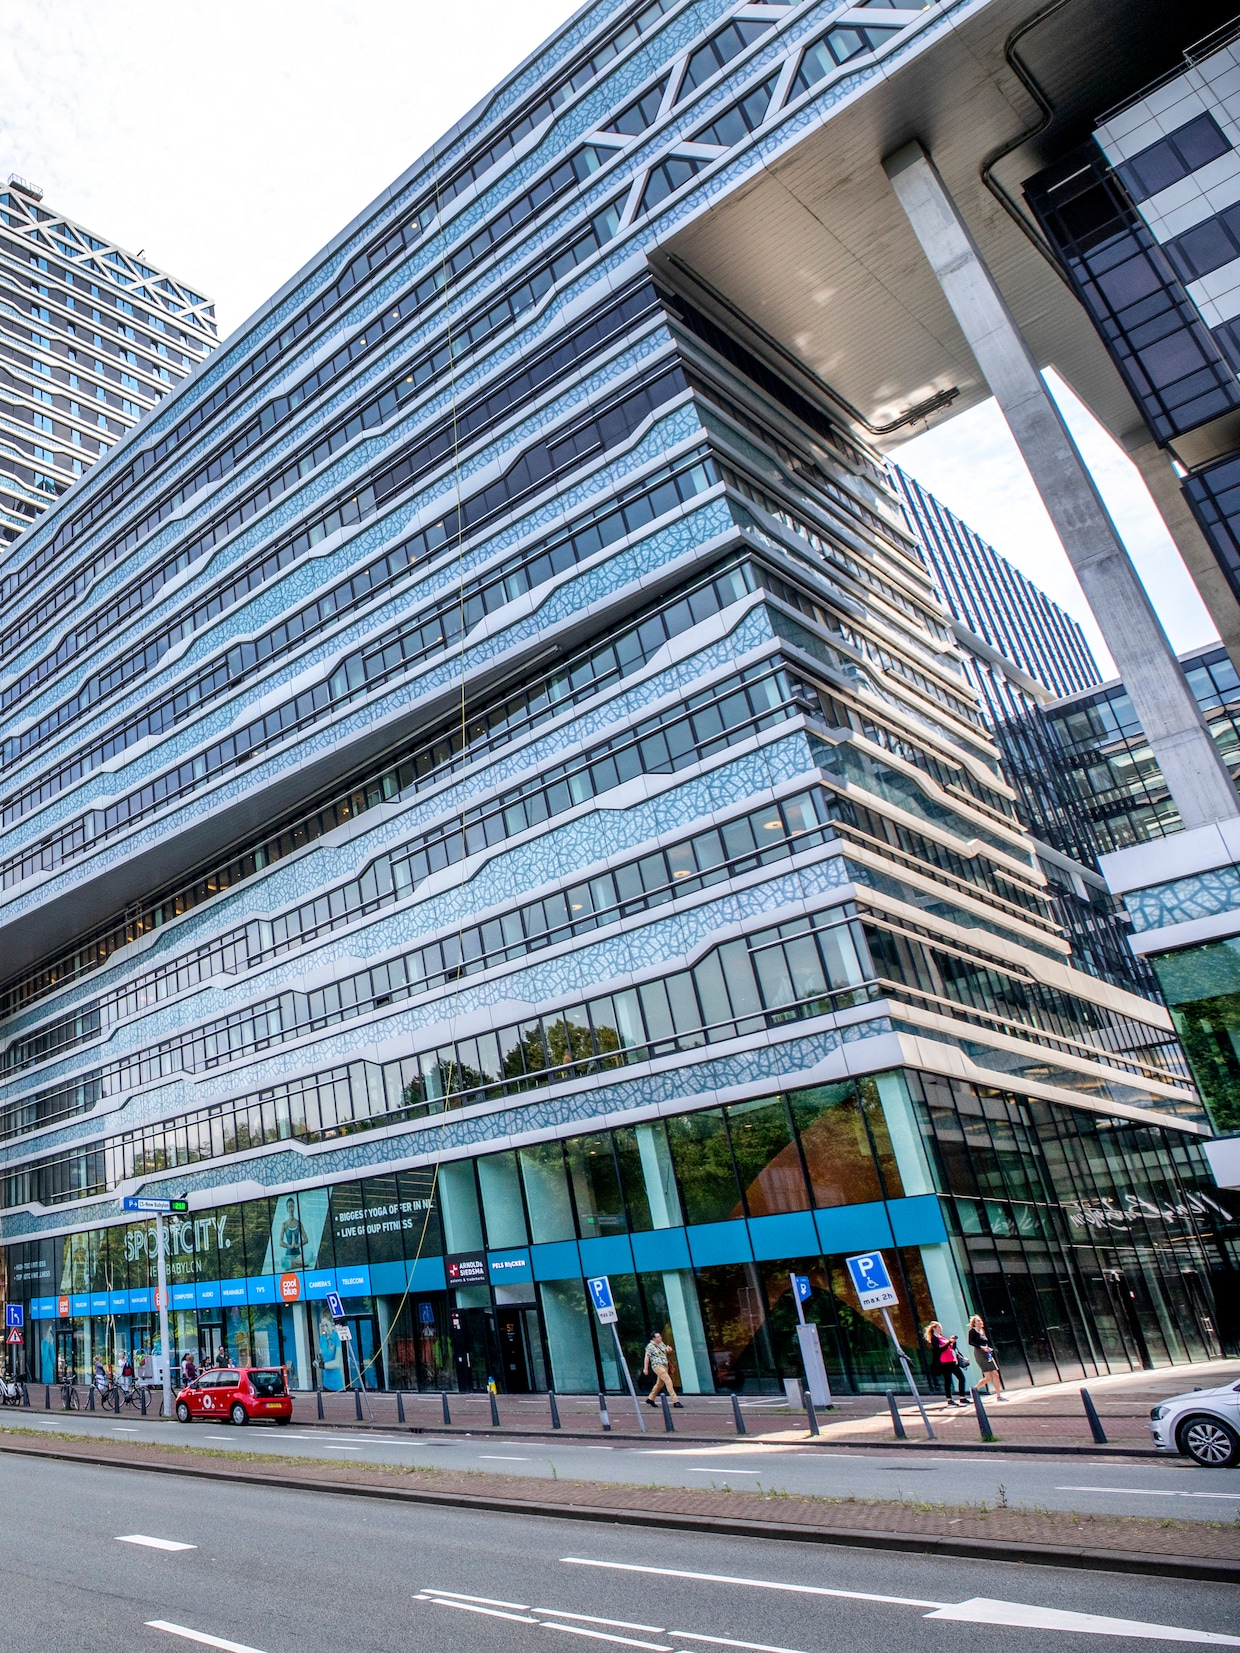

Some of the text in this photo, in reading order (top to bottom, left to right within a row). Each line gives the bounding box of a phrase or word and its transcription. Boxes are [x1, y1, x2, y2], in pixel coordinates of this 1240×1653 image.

[339, 1209, 368, 1222] BIGGEST
[368, 1206, 388, 1217] YOGA
[413, 1200, 421, 1211] IN
[341, 1226, 357, 1238] LIVE
[166, 1260, 202, 1276] BABYLON
[460, 1268, 484, 1277] SIEDSMA
[857, 1258, 874, 1277] P
[282, 1279, 297, 1288] cool
[341, 1277, 364, 1285] TELECOM
[223, 1288, 244, 1296] WEARABLES
[283, 1287, 298, 1296] blue
[593, 1280, 603, 1297] P
[329, 1295, 338, 1315] P
[863, 1293, 893, 1306] max 2h
